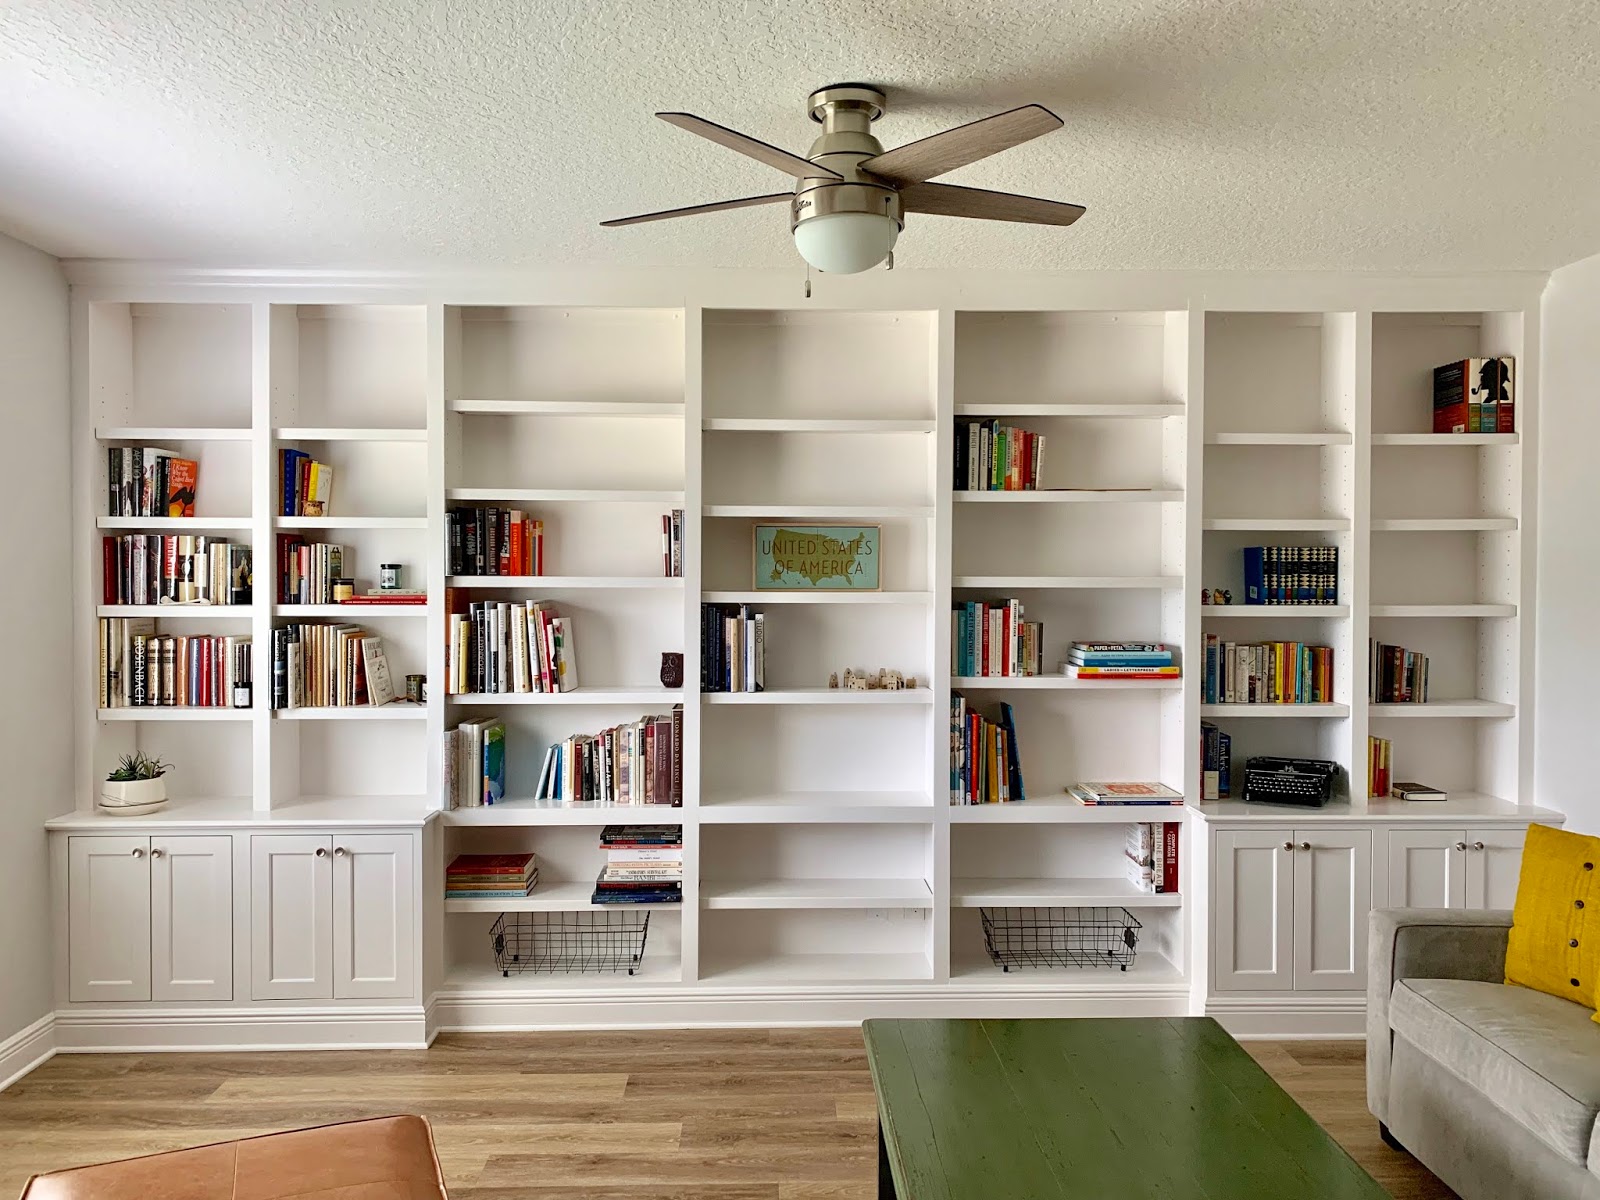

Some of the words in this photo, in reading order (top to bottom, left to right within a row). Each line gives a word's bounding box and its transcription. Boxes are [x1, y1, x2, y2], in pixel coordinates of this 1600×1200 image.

[171, 475, 185, 483] Caged
[762, 540, 816, 555] UNITED
[822, 540, 872, 555] STATES
[774, 560, 793, 574] OF
[800, 560, 864, 574] AMERICA
[134, 640, 145, 703] ROSENBACH
[674, 753, 680, 763] DA
[1219, 739, 1229, 771] Fowler's
